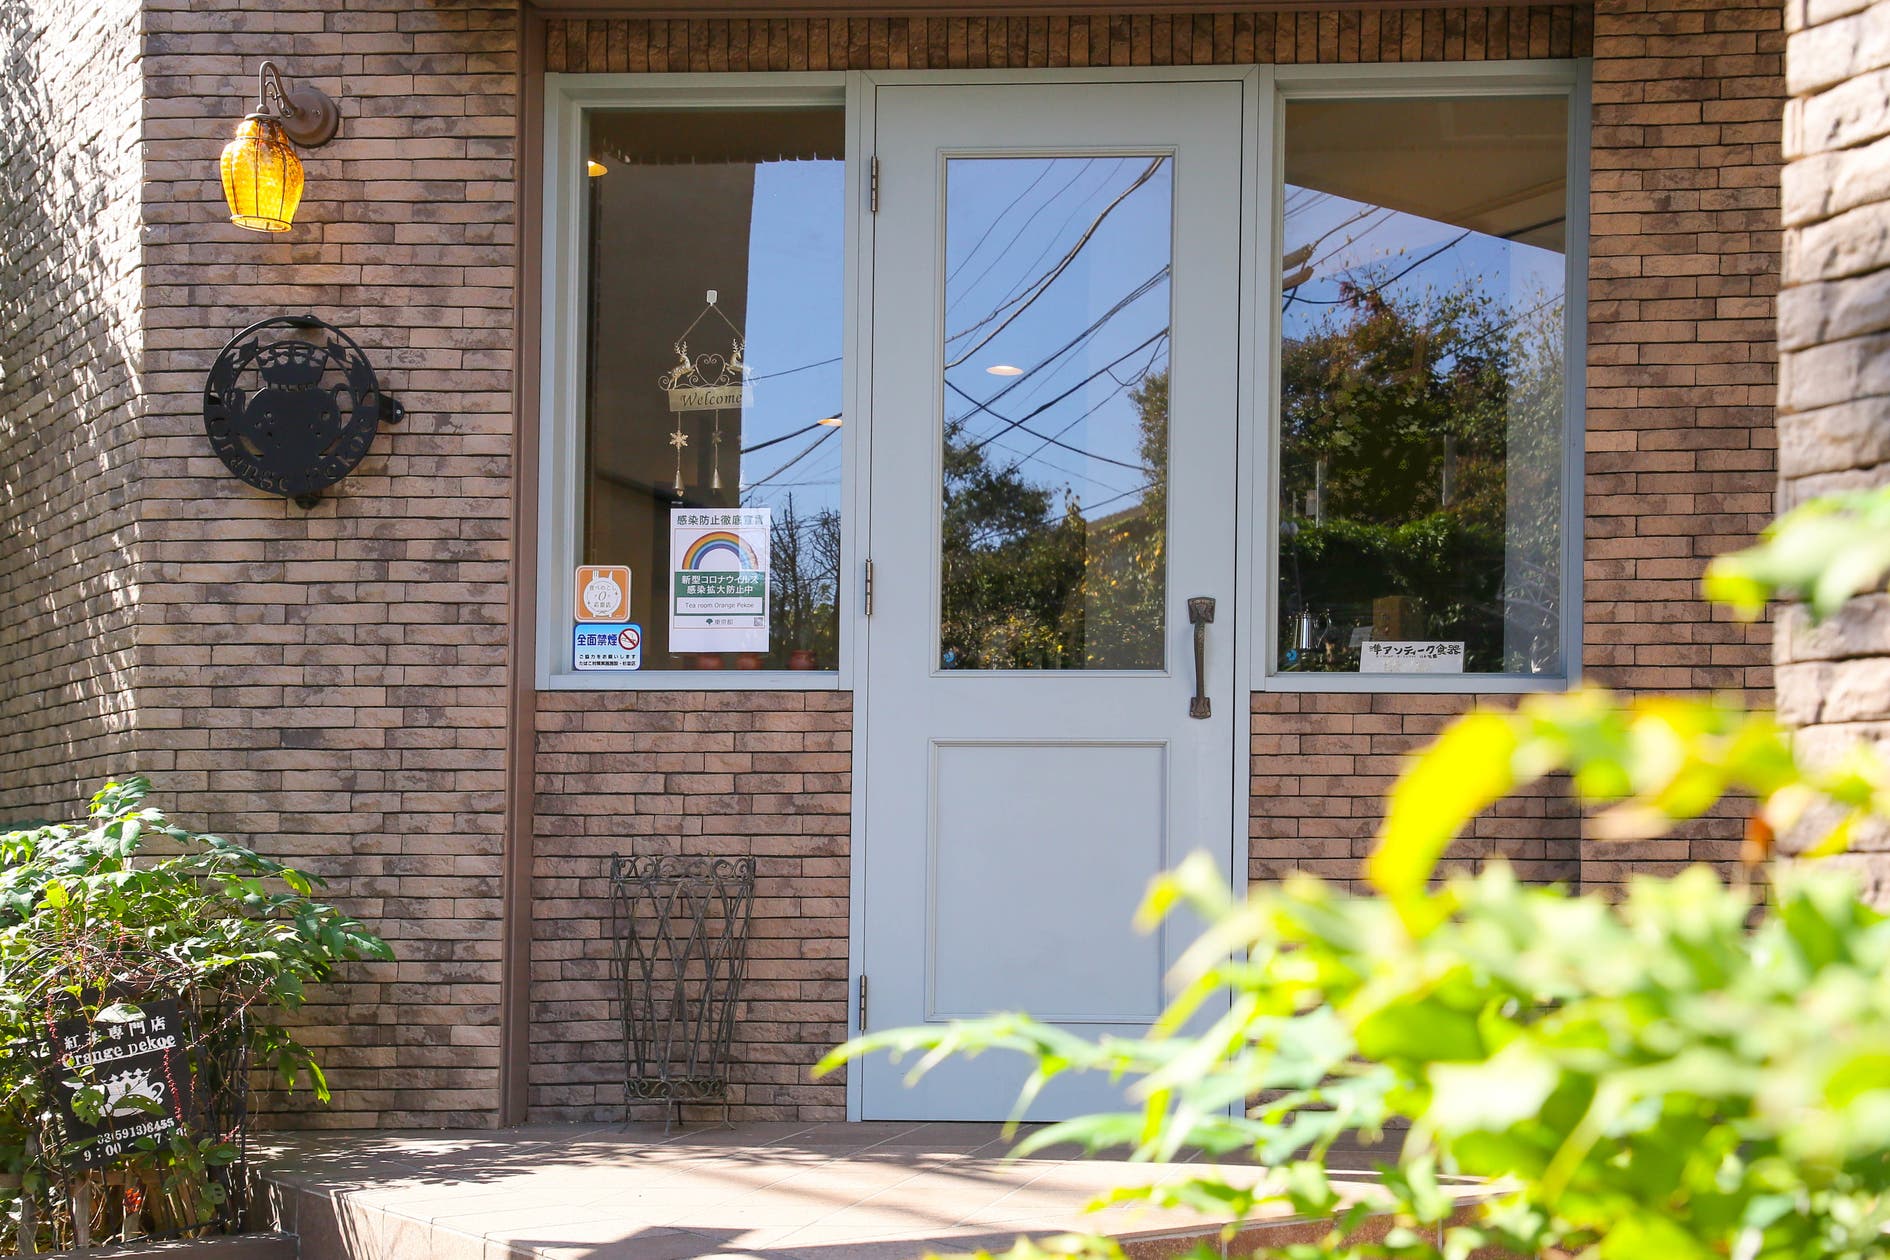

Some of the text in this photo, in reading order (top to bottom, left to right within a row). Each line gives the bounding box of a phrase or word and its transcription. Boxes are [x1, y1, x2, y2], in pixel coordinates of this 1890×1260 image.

[680, 391, 742, 407] Welcome
[681, 575, 759, 585] 新型コロナウイルス
[686, 585, 754, 595] 感染拡大防止中
[714, 602, 736, 610] Orange
[577, 634, 618, 646] 全面禁煙
[128, 1034, 176, 1056] pekoe
